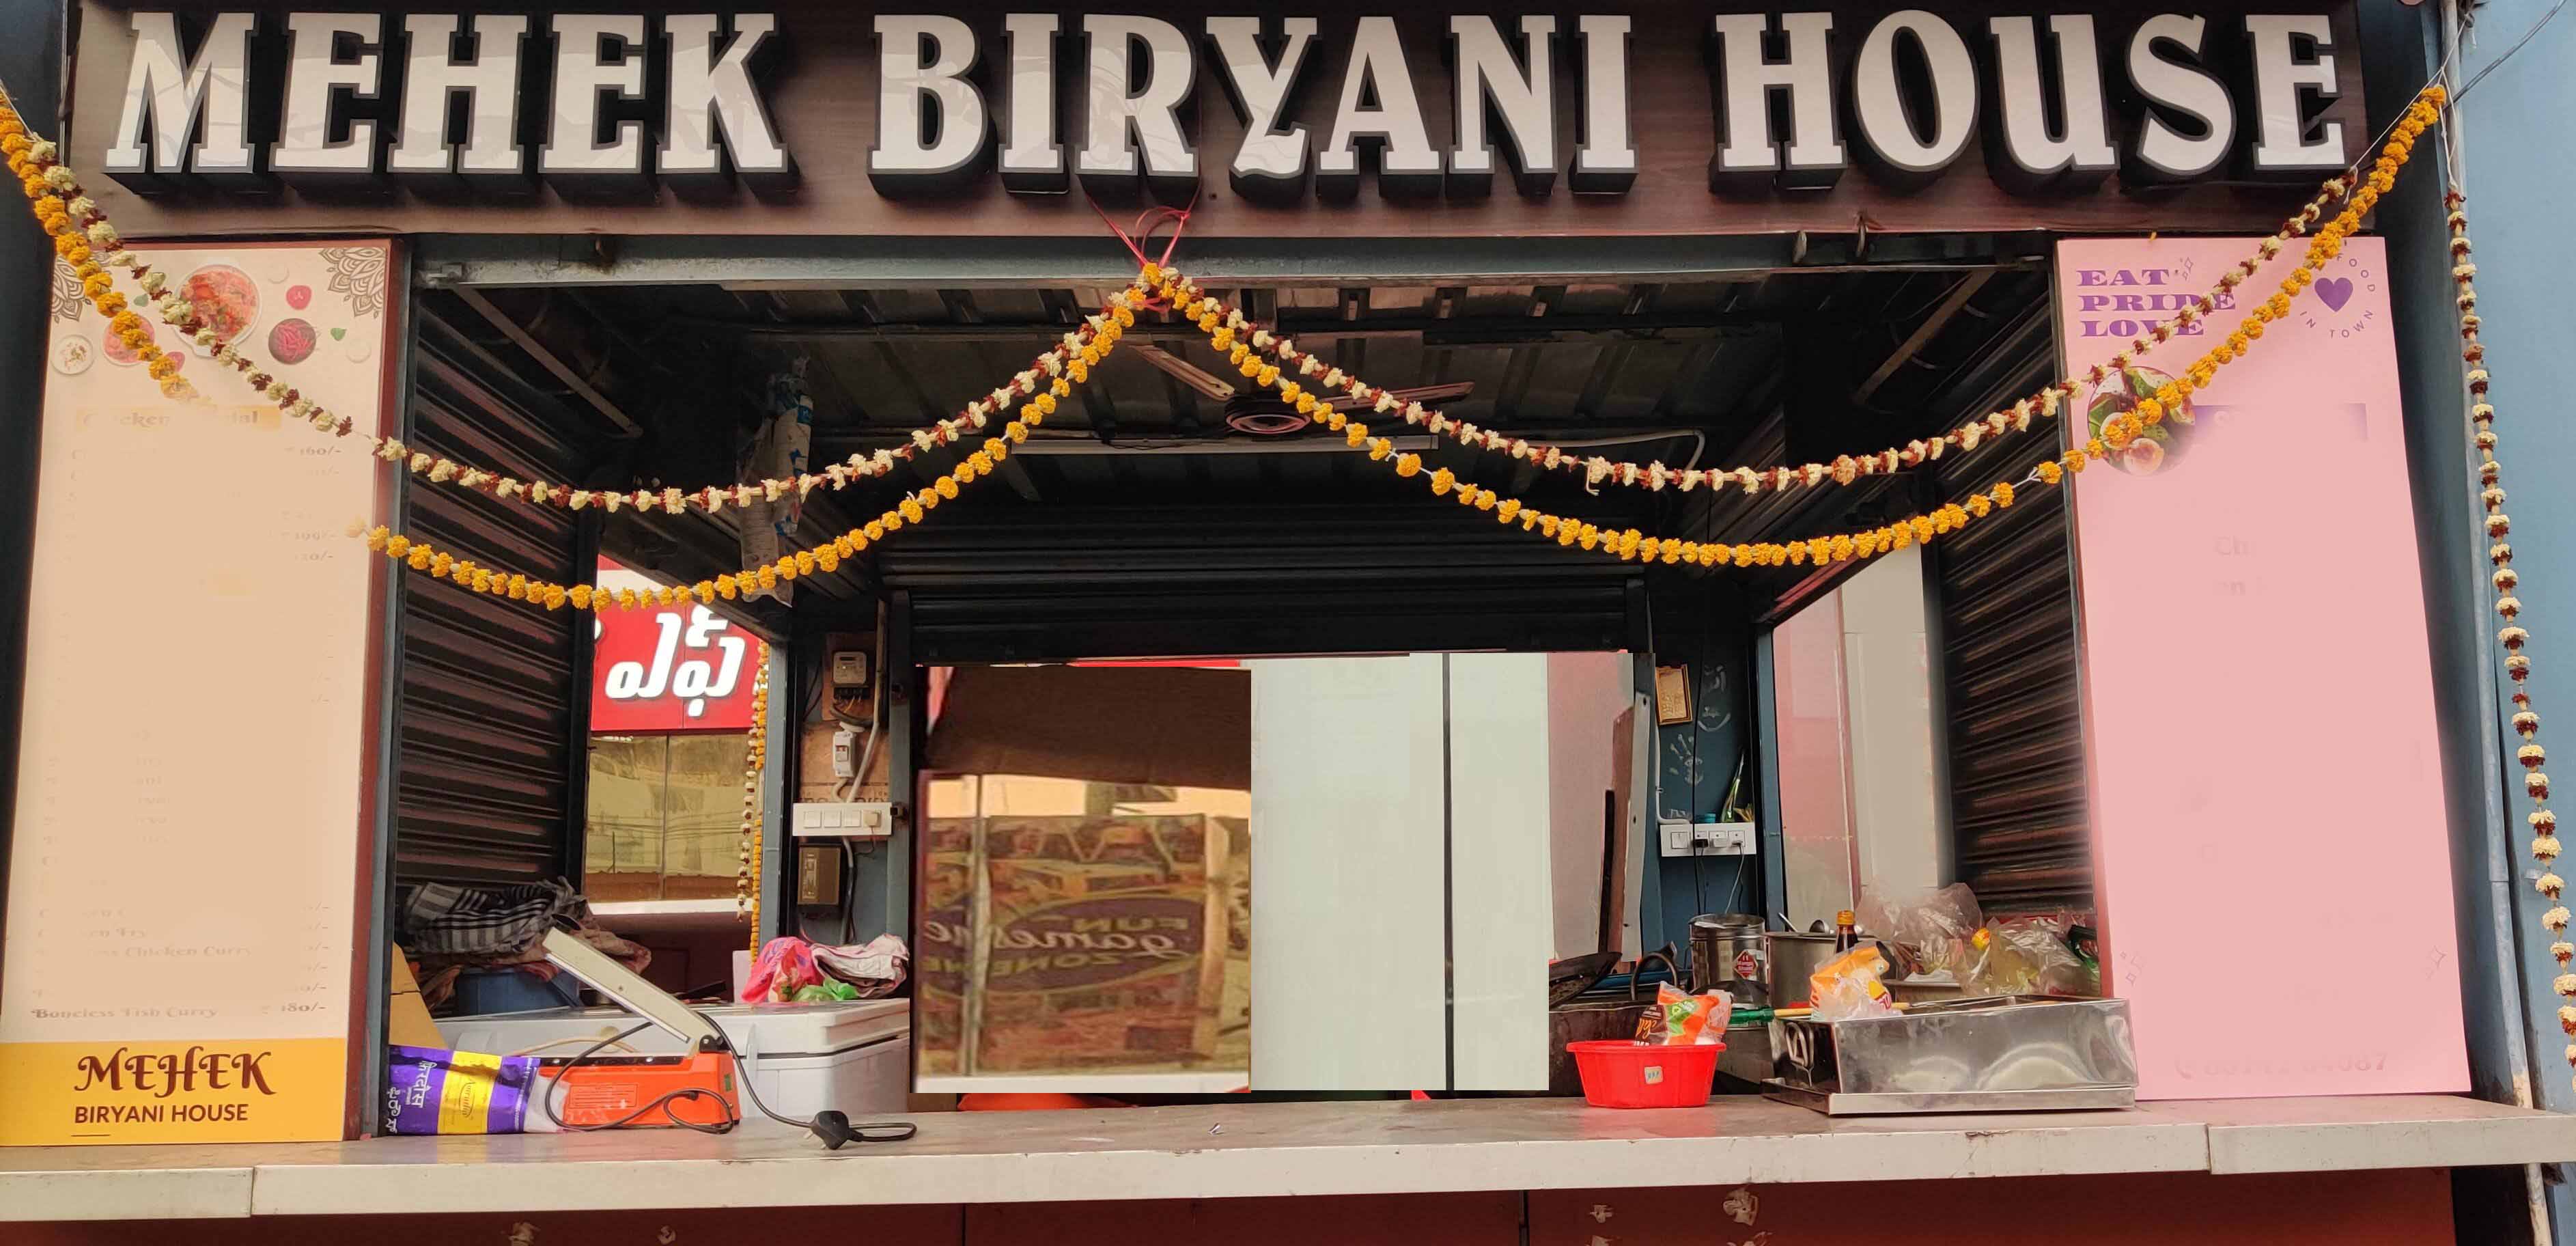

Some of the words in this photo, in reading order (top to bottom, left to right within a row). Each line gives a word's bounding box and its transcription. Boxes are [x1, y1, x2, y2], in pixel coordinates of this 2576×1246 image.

[104, 11, 791, 176] MEHEK
[867, 12, 1640, 179] BIRYANI
[1714, 9, 2348, 174] HOUSE
[2076, 269, 2170, 286] EAT
[2329, 309, 2374, 338] TOWN
[74, 1046, 277, 1098] MEHEK
[74, 1105, 165, 1124] BIRYANI
[171, 1103, 249, 1122] HOUSE
